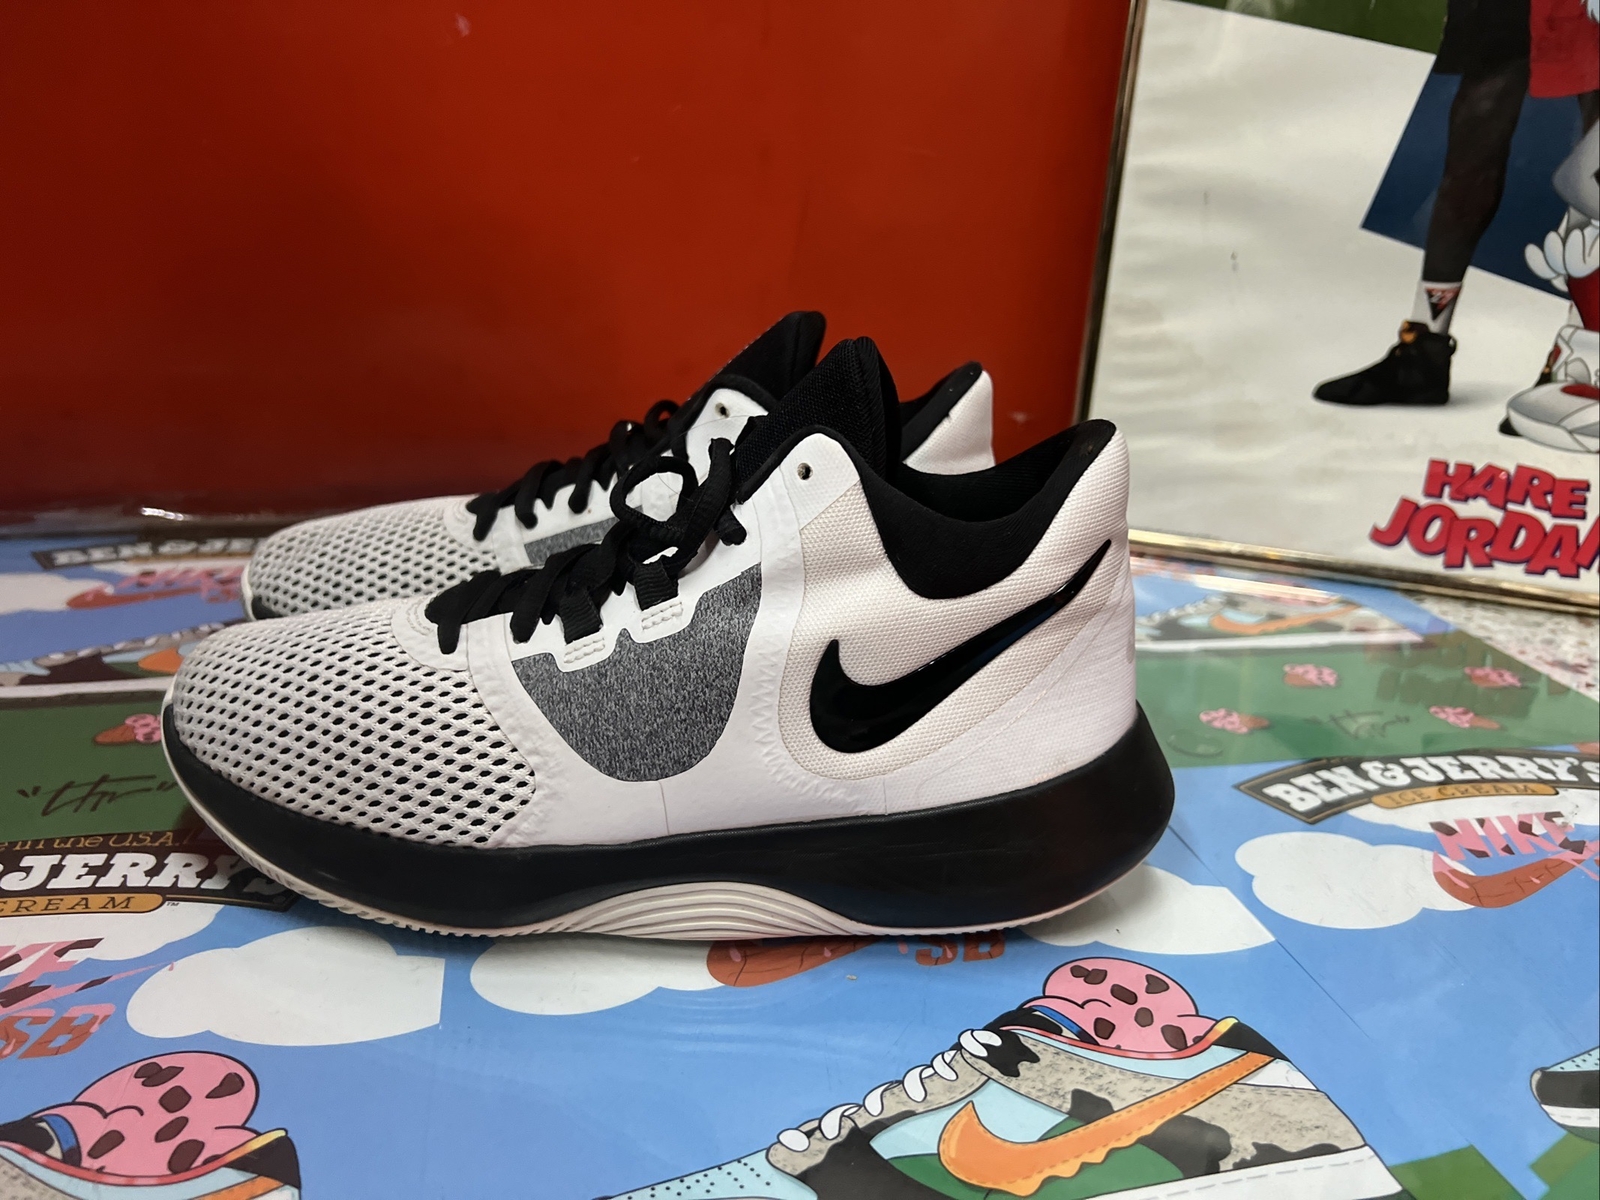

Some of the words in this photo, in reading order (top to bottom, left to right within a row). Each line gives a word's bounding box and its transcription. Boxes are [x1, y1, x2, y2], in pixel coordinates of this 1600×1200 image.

[1423, 457, 1591, 519] HARE
[1262, 765, 1380, 812] BEN
[1360, 760, 1412, 787] &
[1399, 755, 1599, 783] JERRY'S
[1385, 789, 1431, 805] ICE
[1438, 784, 1539, 798] CREAM
[1429, 811, 1588, 861] NIKE
[0, 851, 288, 896] JERRY
[0, 896, 137, 915] REAM
[0, 1003, 116, 1060] SB
